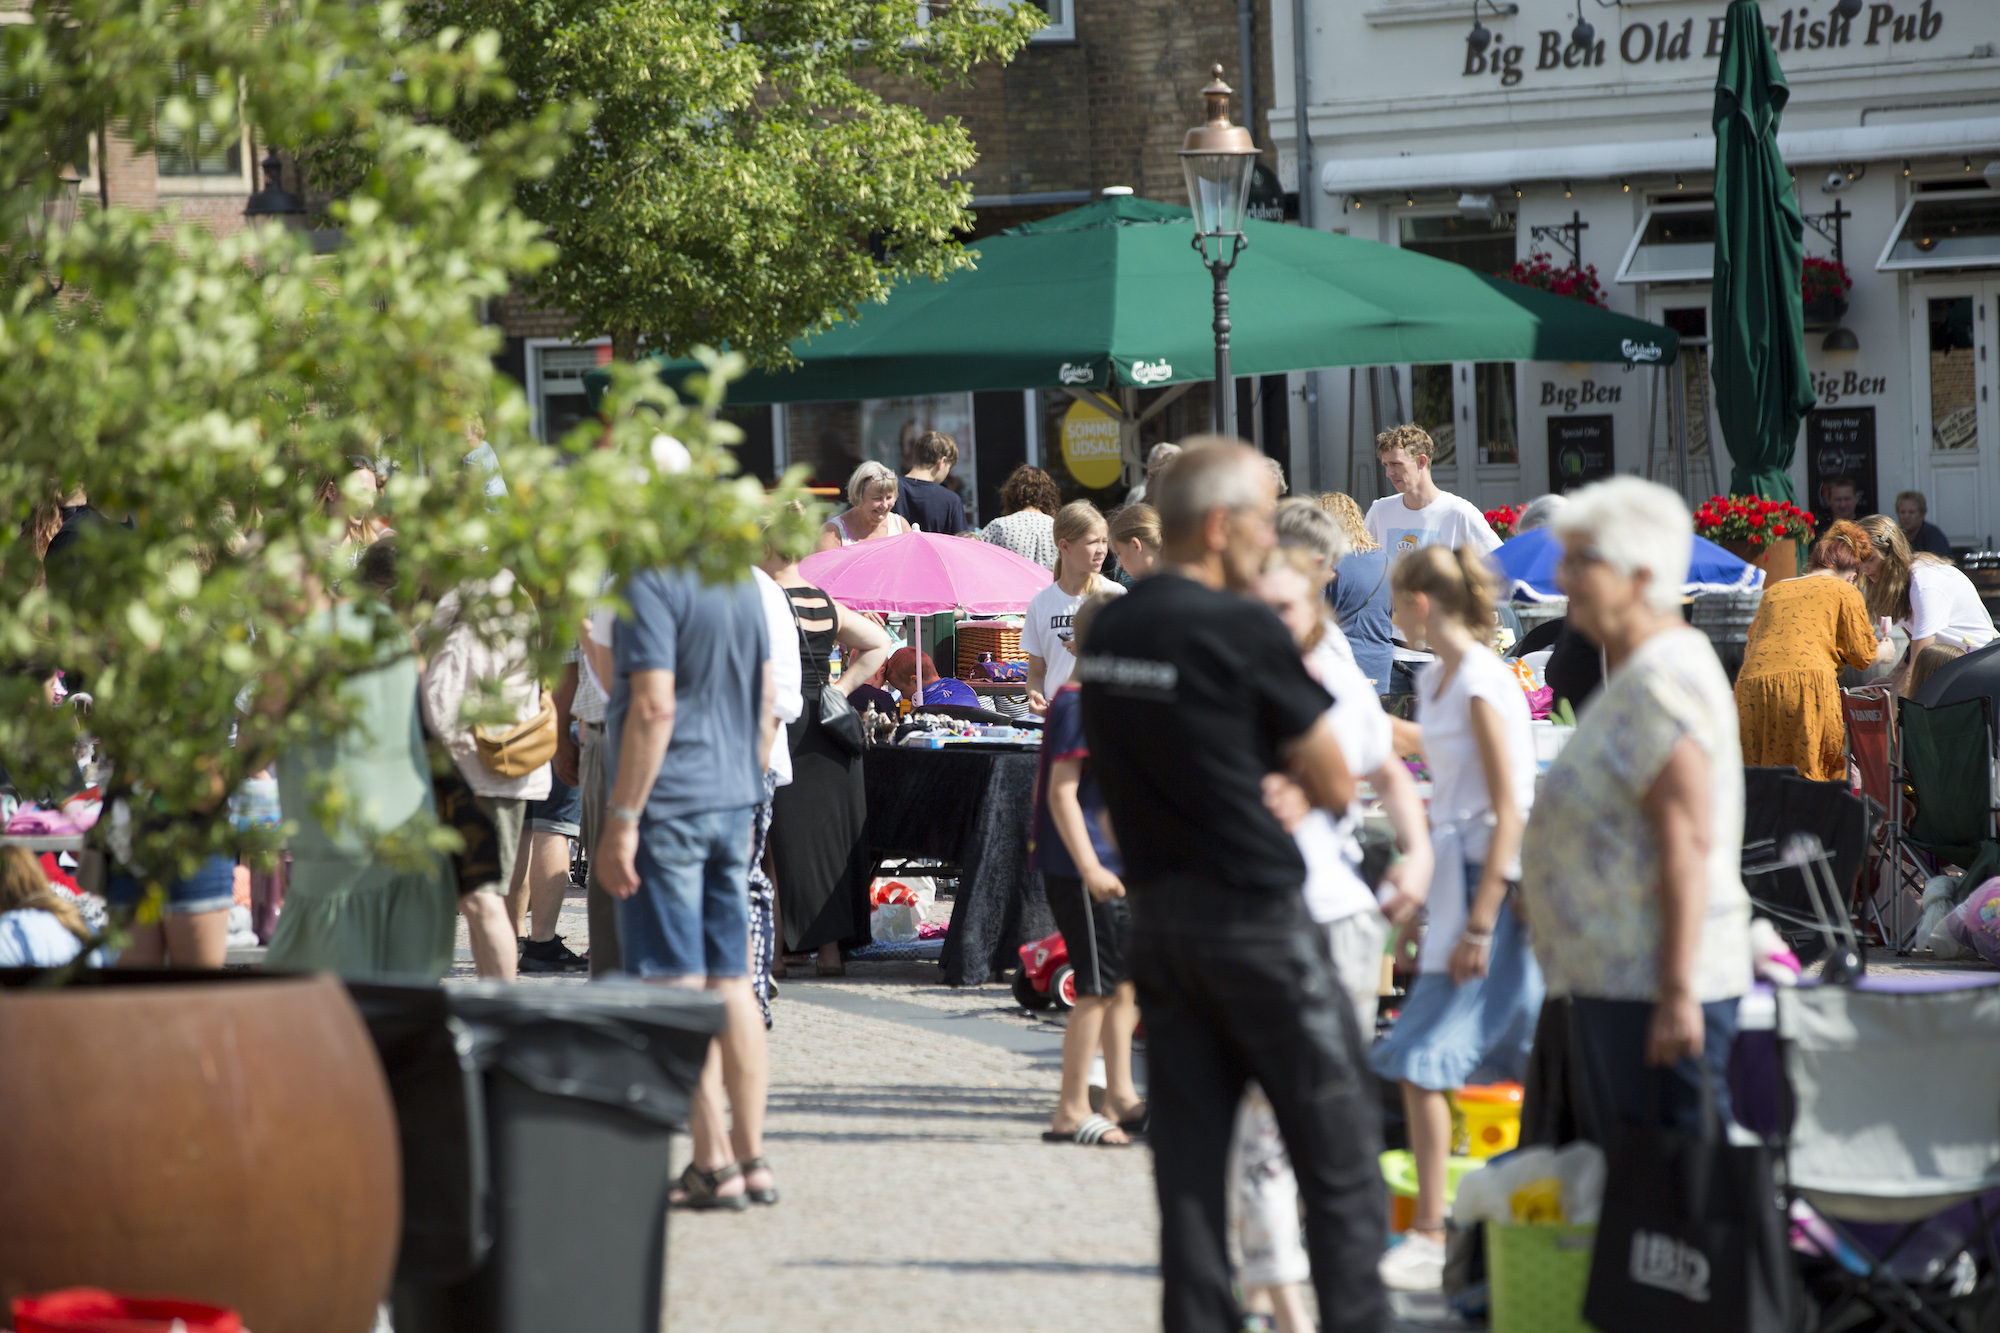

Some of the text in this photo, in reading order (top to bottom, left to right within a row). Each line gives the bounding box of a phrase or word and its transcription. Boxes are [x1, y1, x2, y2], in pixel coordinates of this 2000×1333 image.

[1536, 29, 1605, 71] Ben
[1620, 18, 1693, 64] Old
[1864, 0, 1943, 46] Pub
[1621, 338, 1663, 362] Carlsberg
[1059, 362, 1094, 385] Carlsberg
[1131, 358, 1173, 385] Carlsberg
[1821, 418, 1842, 430] Happy
